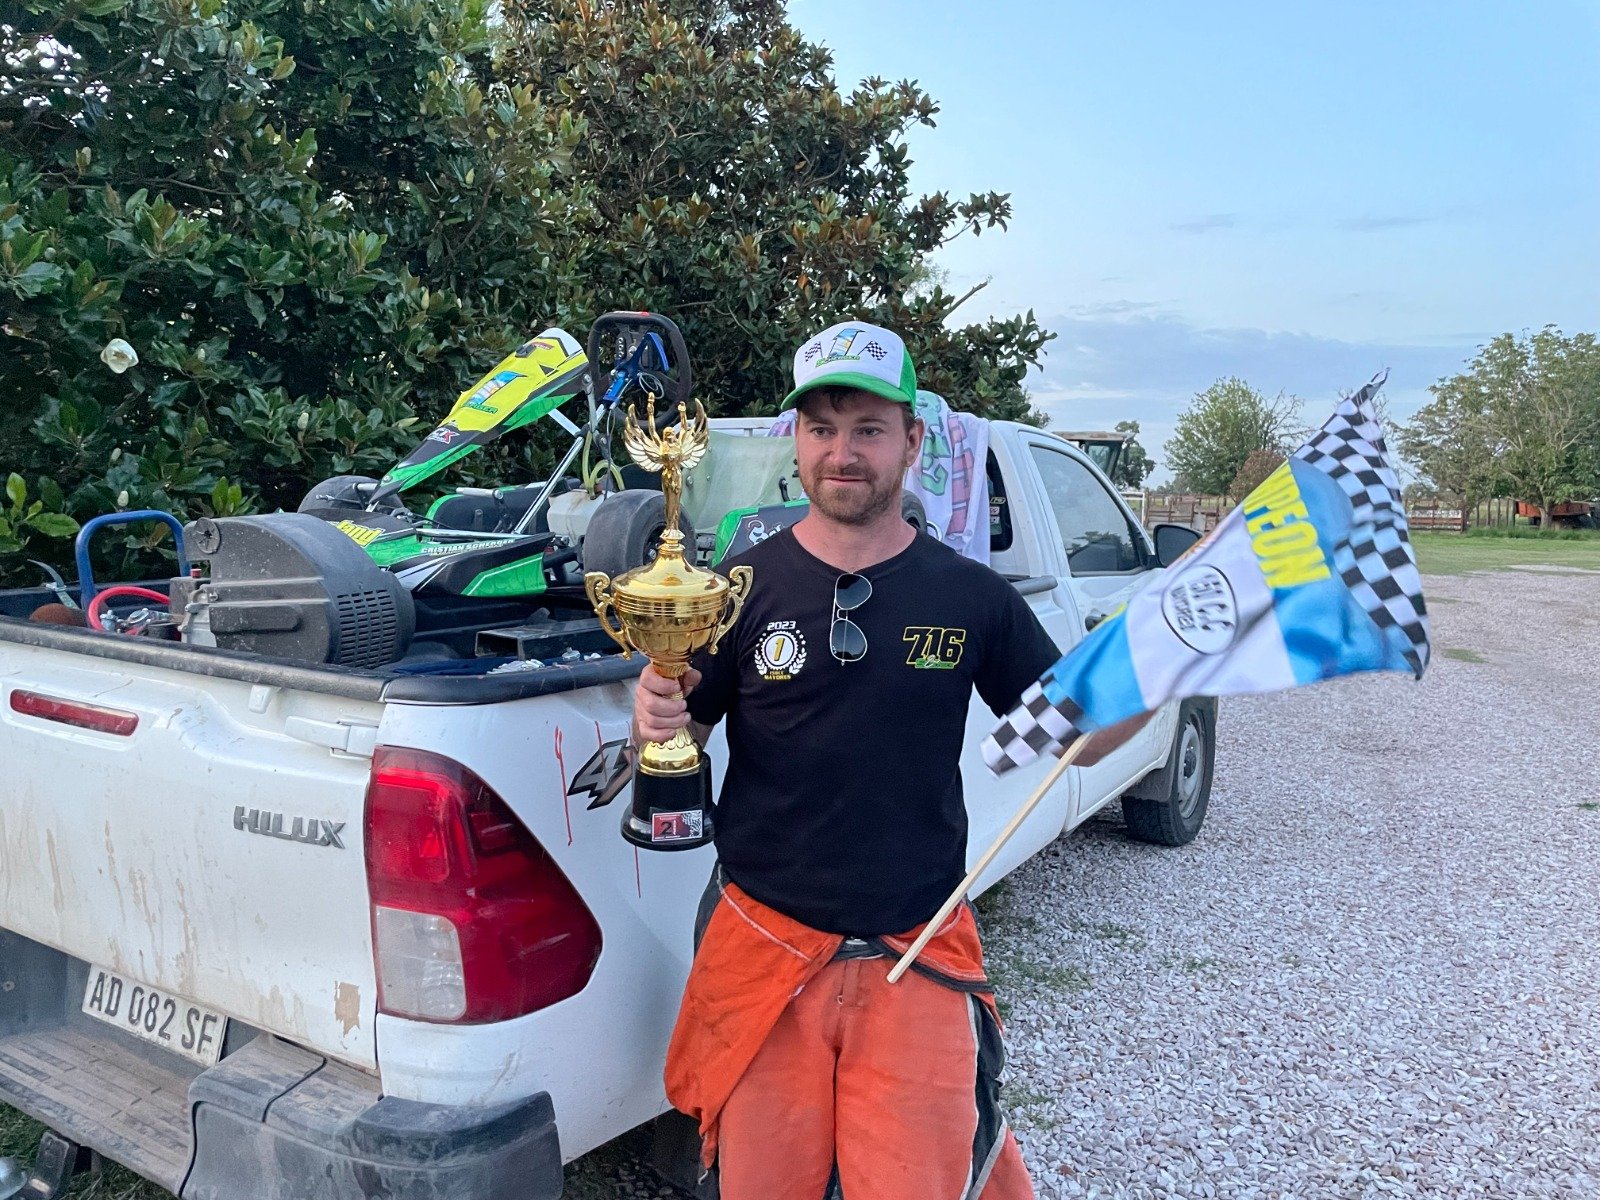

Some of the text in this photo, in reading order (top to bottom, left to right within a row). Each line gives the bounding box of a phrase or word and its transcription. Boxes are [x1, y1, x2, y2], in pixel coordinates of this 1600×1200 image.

[421, 544, 464, 554] CRISTIAN
[766, 620, 797, 631] 2023
[773, 637, 786, 662] 1
[902, 626, 966, 666] 716
[233, 805, 347, 849] HILUX
[89, 971, 218, 1054] AD 082 SF
